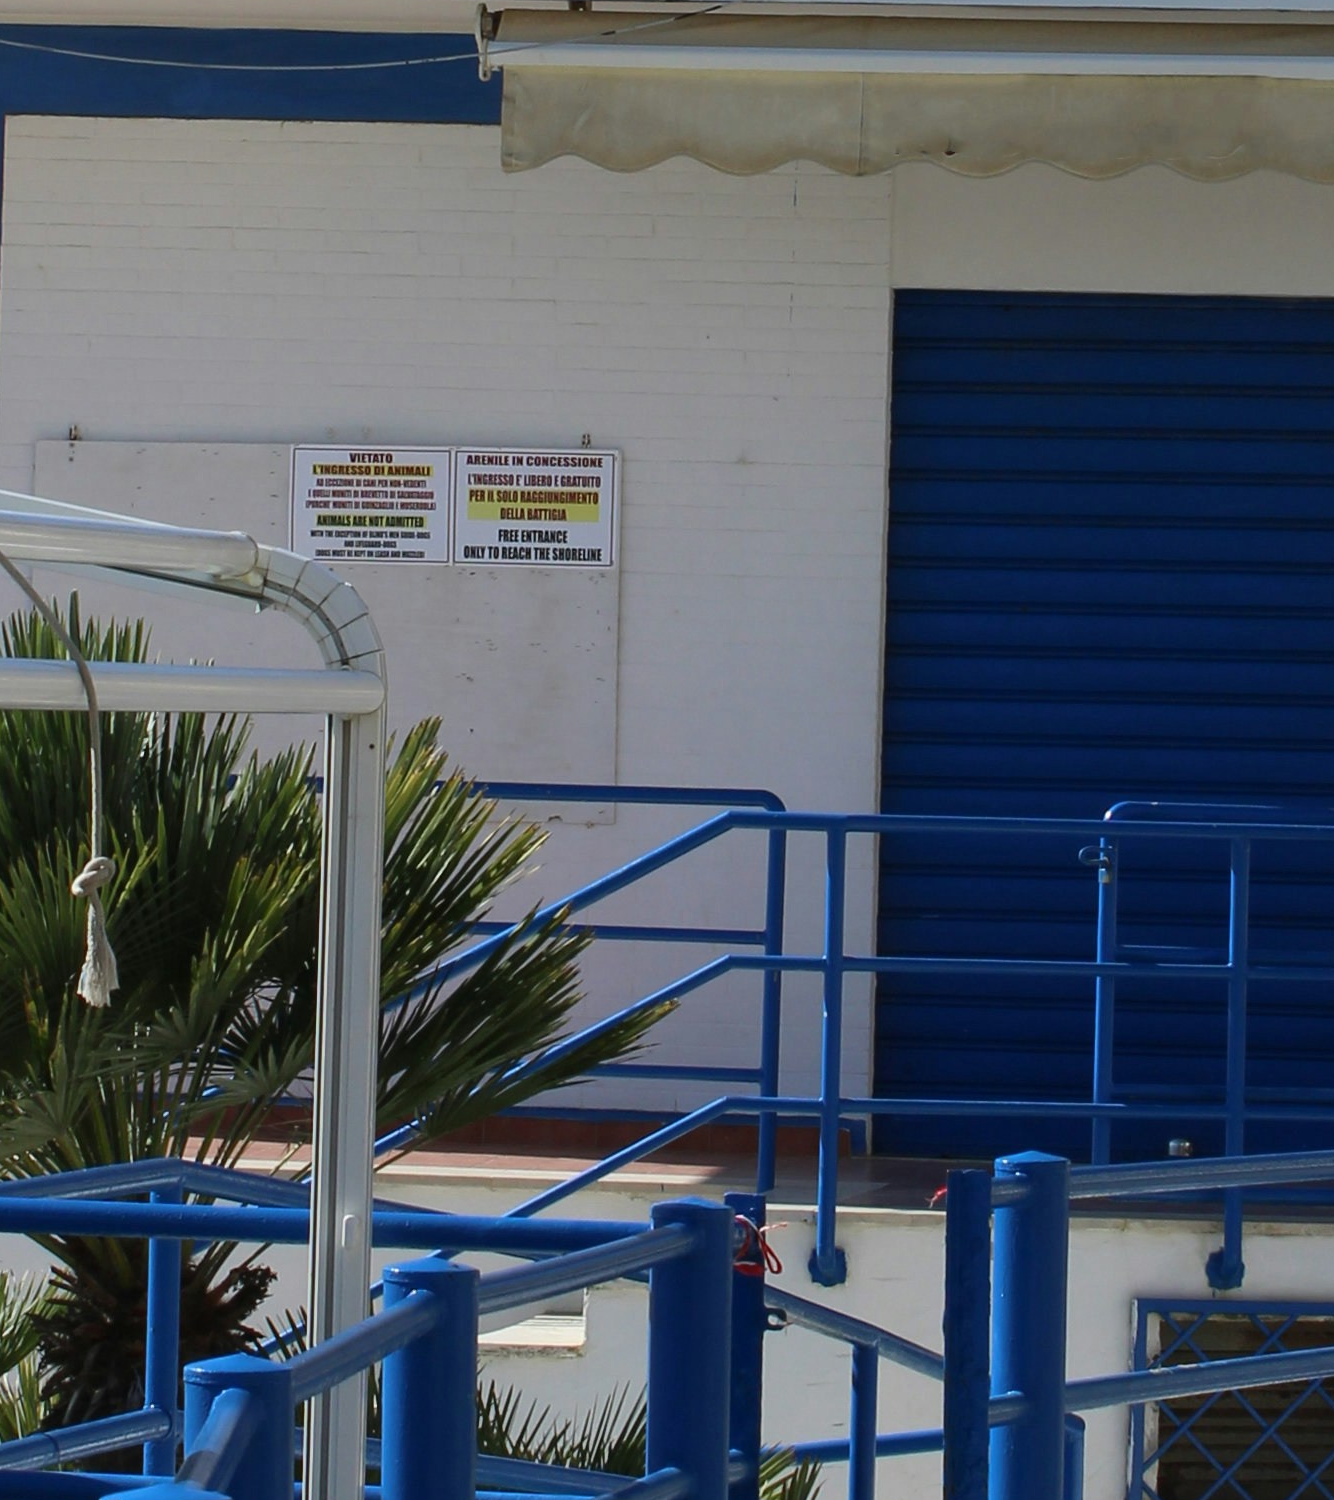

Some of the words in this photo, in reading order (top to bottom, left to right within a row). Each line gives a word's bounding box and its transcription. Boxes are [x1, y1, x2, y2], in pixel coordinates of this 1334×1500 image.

[349, 453, 393, 463] VIETATO
[466, 455, 509, 465] ARENILE
[512, 455, 523, 466] IN
[526, 456, 603, 467] CONCESSIONE
[313, 464, 371, 475] L'INGRESSO
[374, 465, 385, 476] DI
[387, 466, 430, 476] ANIMALI
[468, 474, 514, 486] L'INGRESSO
[524, 475, 552, 487] LIBERO
[555, 475, 559, 487] E
[561, 476, 601, 488] GRATUITO
[469, 490, 485, 502] PER
[487, 490, 495, 502] IL
[497, 491, 518, 503] SOLO
[520, 491, 599, 503] RAGGIUNGIMENTO
[500, 507, 525, 520] DELLA
[527, 508, 567, 521] BATTIGIA
[317, 515, 351, 526] ANIMALS
[352, 516, 367, 527] ARE
[368, 516, 384, 527] NOT
[385, 517, 424, 528] ADMITTED
[498, 529, 519, 542] FREE
[521, 530, 568, 543] ENTRANCE
[464, 545, 485, 559] ONLY
[487, 546, 500, 559] TO
[501, 546, 531, 560] REACH
[534, 547, 550, 560] THE
[551, 547, 602, 561] SHORELINE
